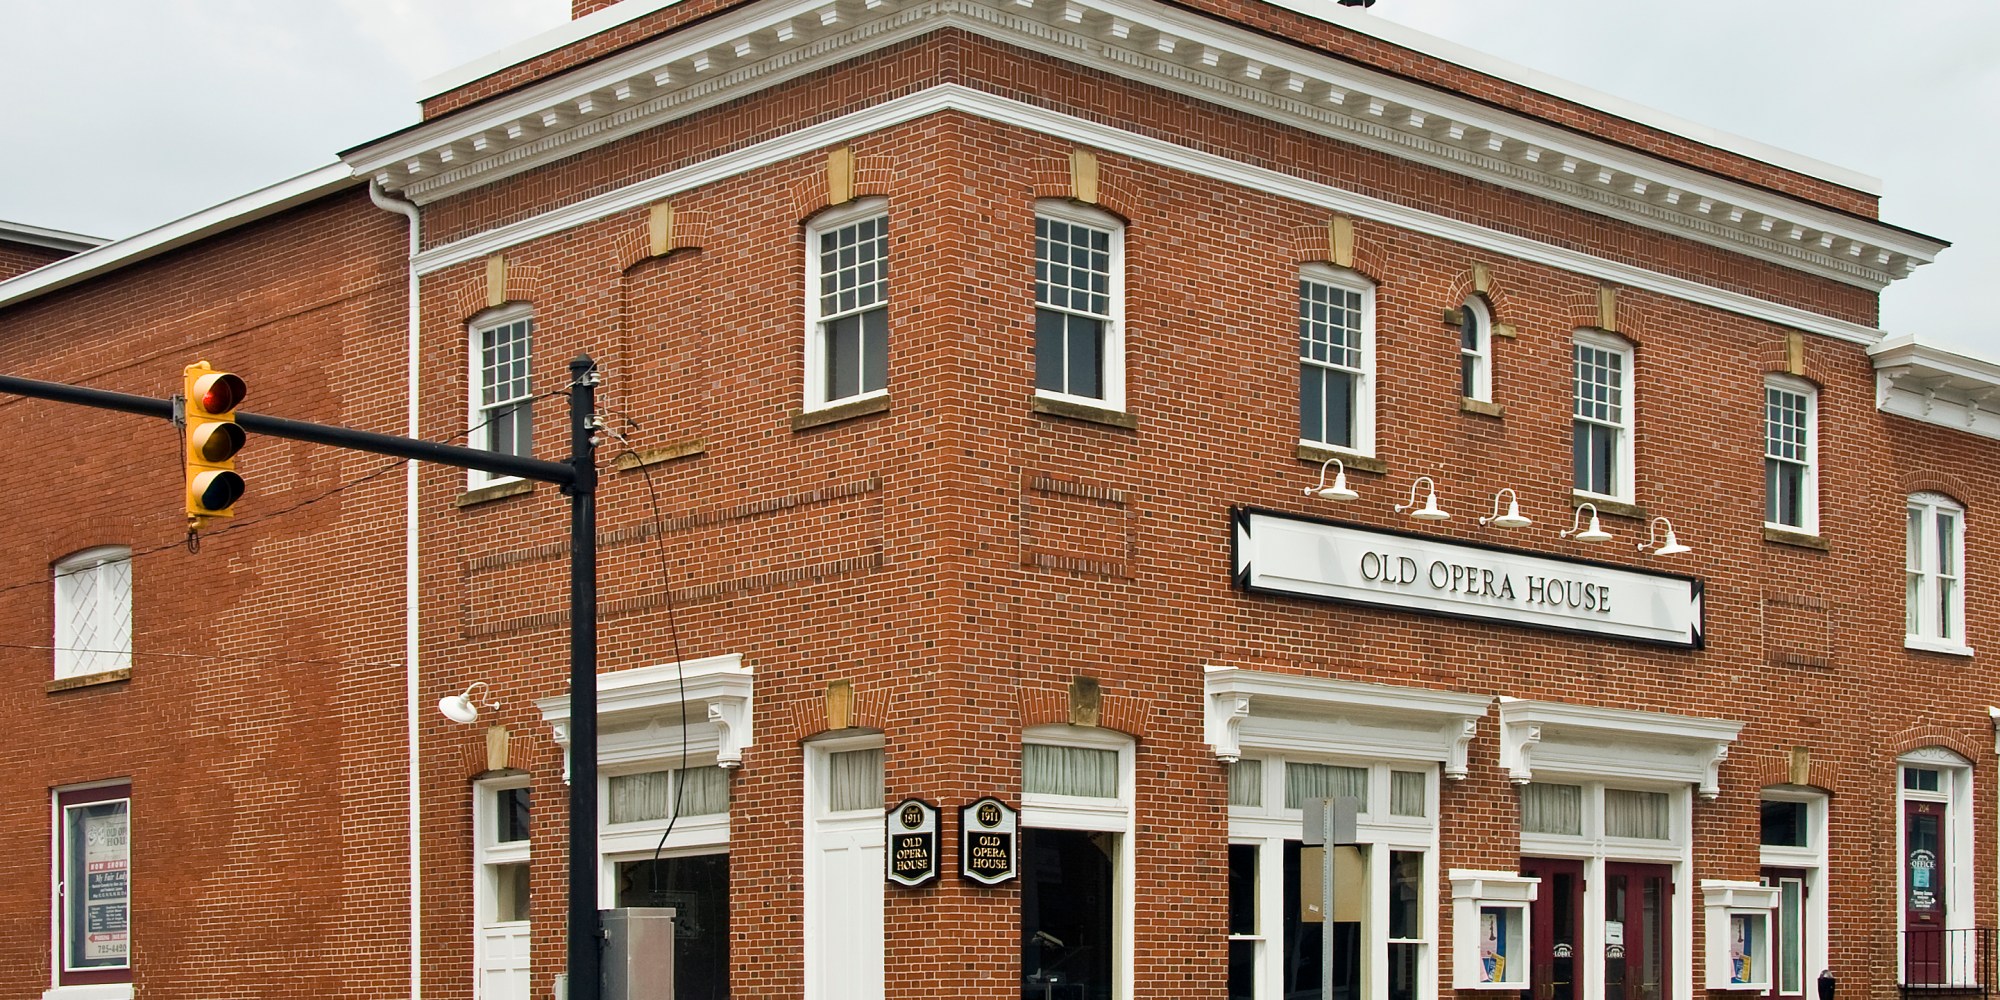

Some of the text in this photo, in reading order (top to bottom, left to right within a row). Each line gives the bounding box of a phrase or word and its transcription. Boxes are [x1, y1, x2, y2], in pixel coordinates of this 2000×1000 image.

[1360, 550, 1612, 614] OLD OPERA HOUSE
[904, 813, 921, 823] 1911
[981, 812, 998, 822] 1911
[902, 837, 922, 848] OLD
[979, 836, 1000, 846] OLD
[896, 848, 928, 860] OPERA
[973, 846, 1006, 858] OPERA
[897, 859, 928, 871] HOUSE
[973, 858, 1007, 869] HOUSE
[1911, 860, 1934, 868] OFFICE
